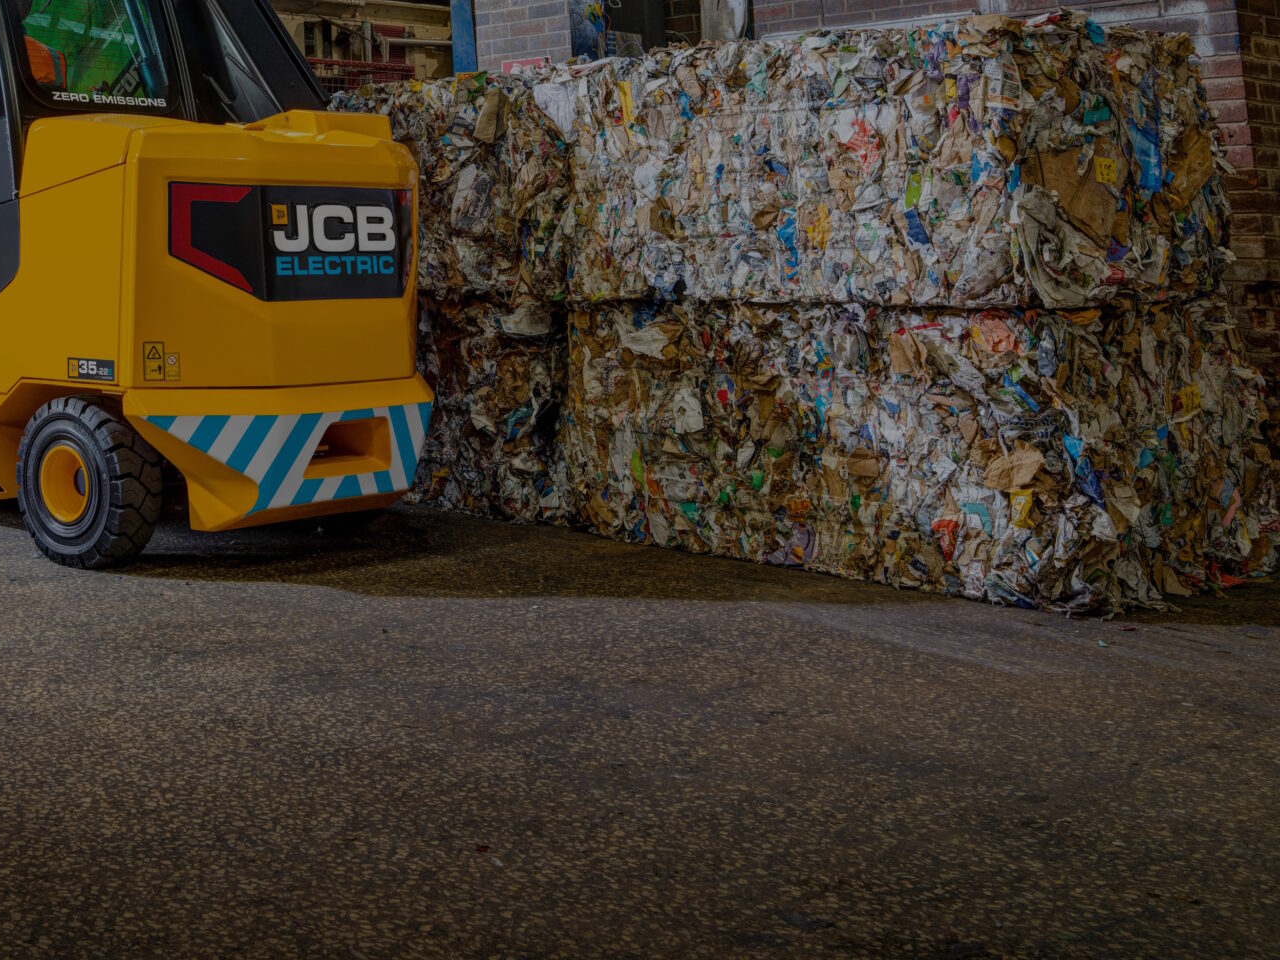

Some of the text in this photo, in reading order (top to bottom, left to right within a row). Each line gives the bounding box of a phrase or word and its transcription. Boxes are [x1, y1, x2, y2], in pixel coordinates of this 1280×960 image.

[52, 91, 167, 107] ZERO EMISSIONS
[272, 204, 396, 252] JCB
[276, 255, 395, 276] ELECTRIC
